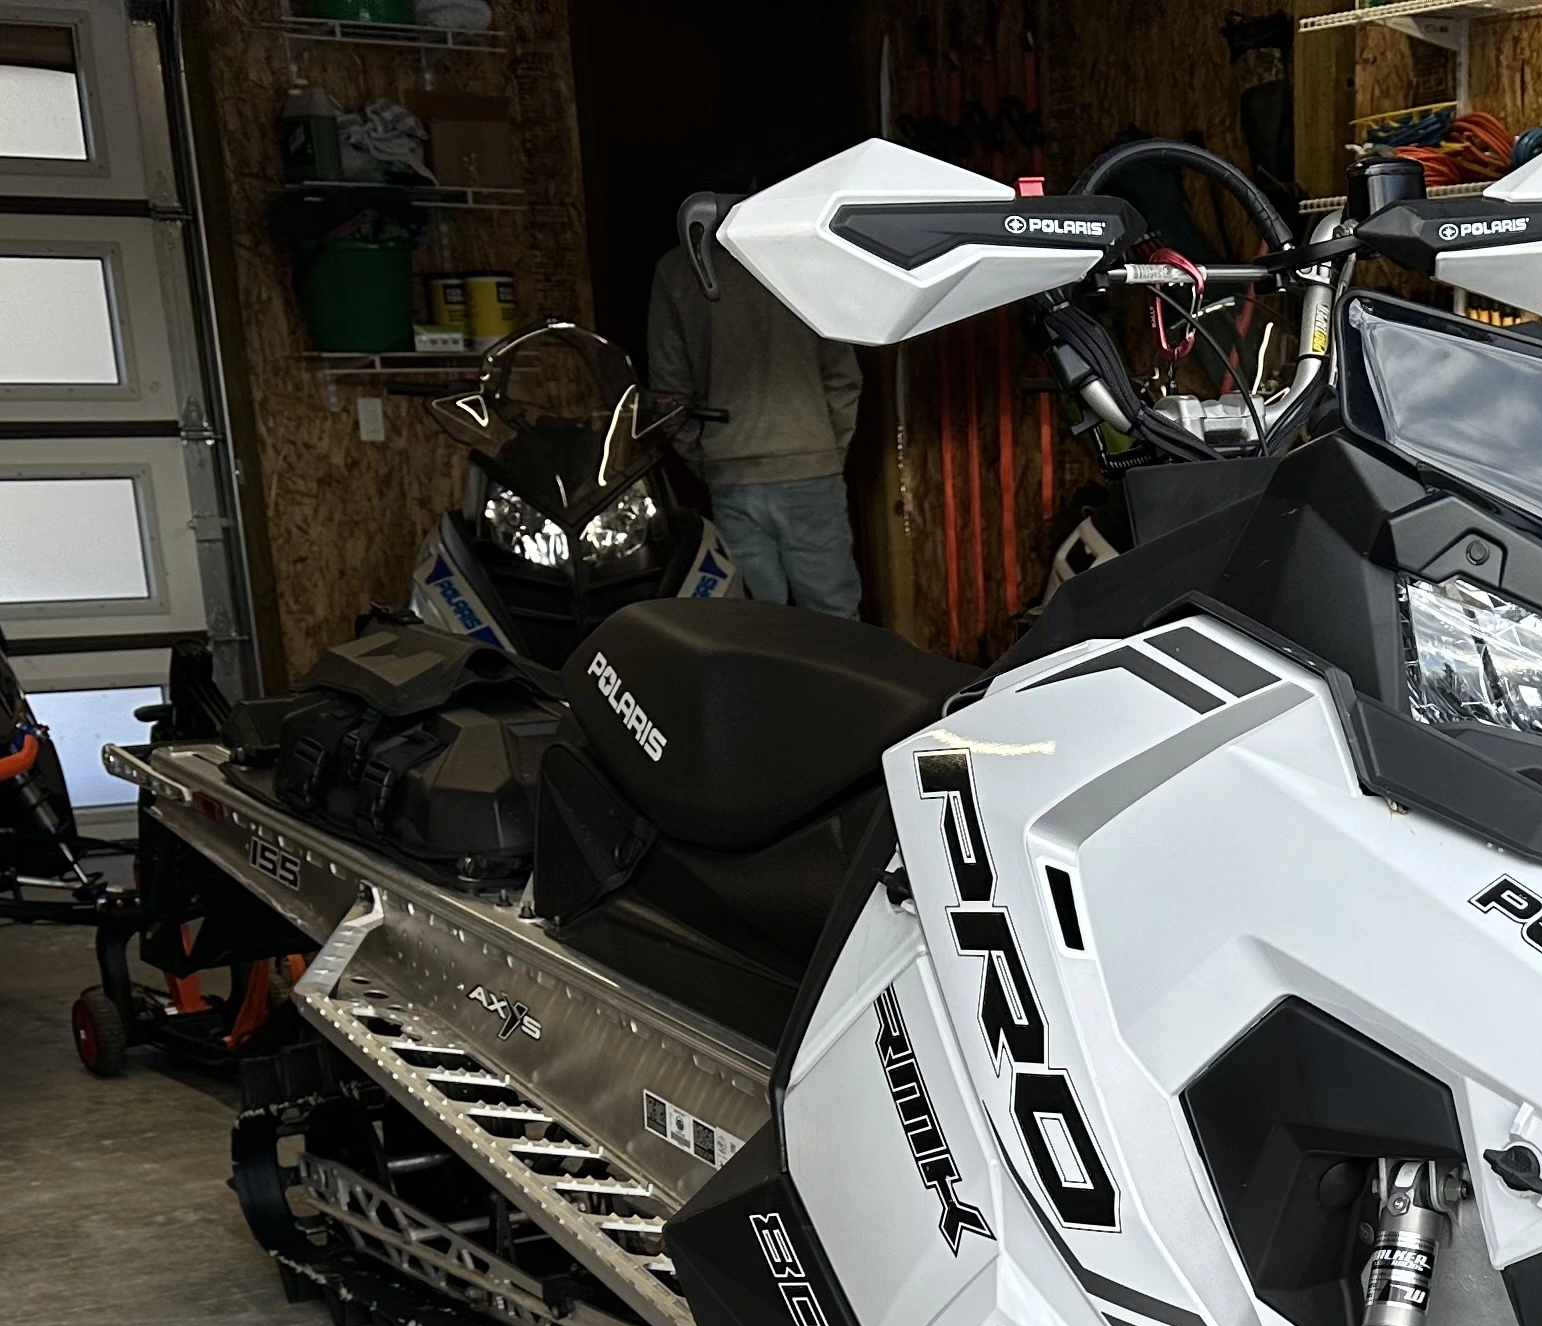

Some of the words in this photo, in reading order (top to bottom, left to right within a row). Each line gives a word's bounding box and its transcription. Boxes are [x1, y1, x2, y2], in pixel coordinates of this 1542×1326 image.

[1028, 218, 1105, 236] POLARIS
[1460, 217, 1529, 237] POLARIS
[435, 581, 482, 629] POLARIS
[587, 651, 667, 762] POLARIS
[249, 836, 300, 891] 155
[467, 986, 542, 1040] AXYS
[913, 747, 1122, 1233] PRO
[873, 982, 997, 1258] RMK
